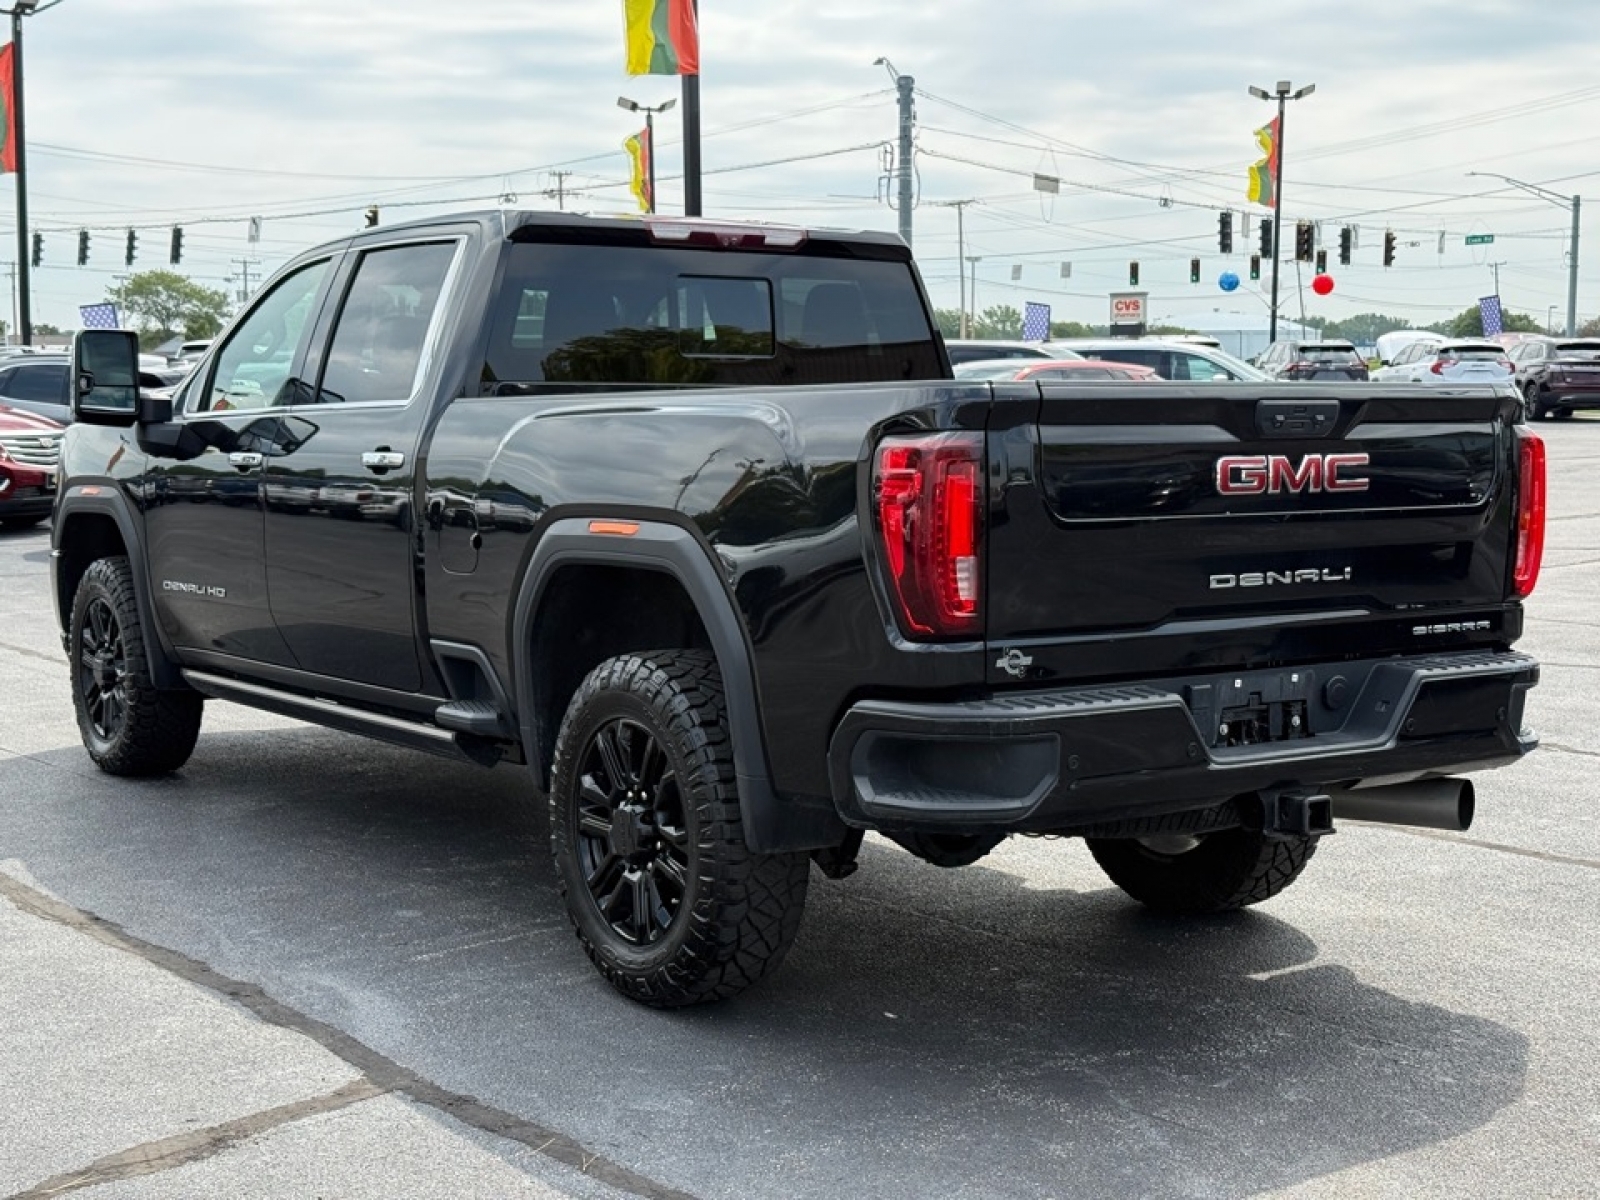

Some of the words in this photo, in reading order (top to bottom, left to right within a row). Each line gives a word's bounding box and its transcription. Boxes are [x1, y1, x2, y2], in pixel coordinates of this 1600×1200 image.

[1115, 300, 1140, 311] CVS
[1216, 453, 1370, 495] GMC
[1209, 567, 1352, 589] DENALI
[163, 580, 205, 594] DENALI
[207, 586, 226, 598] HD
[1412, 620, 1490, 635] SIERRA
